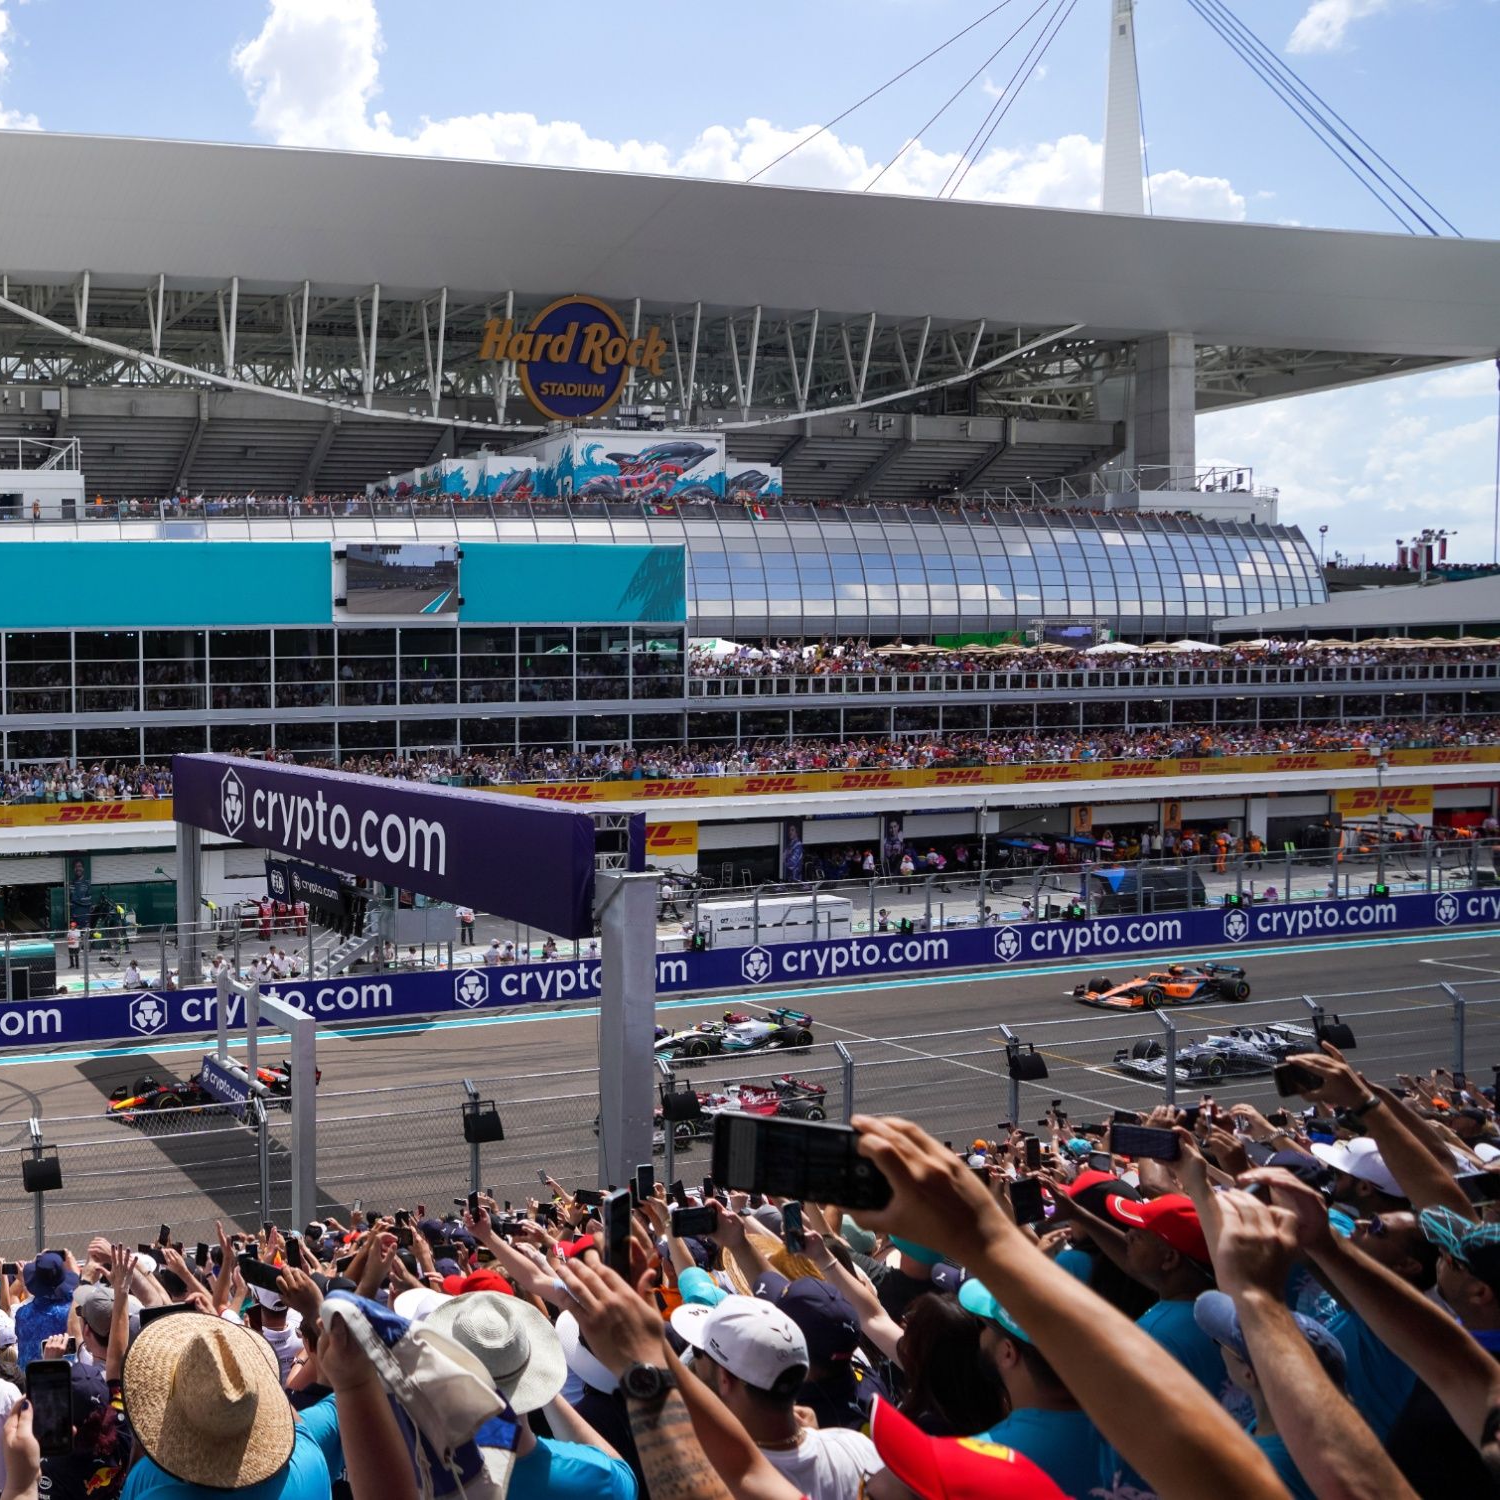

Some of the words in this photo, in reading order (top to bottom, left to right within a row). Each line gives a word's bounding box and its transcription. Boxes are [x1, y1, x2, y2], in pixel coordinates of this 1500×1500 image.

[480, 318, 578, 364] Hard
[579, 322, 668, 376] Rock
[540, 381, 606, 398] STADIUM
[1275, 756, 1319, 769] DHL
[1431, 750, 1474, 763] DHL
[935, 770, 985, 784] DHL
[1024, 766, 1073, 780] DHL
[1111, 763, 1157, 776] DHL
[642, 781, 701, 796] DHL
[744, 777, 799, 792] DHL
[841, 774, 893, 788] DHL
[534, 785, 593, 800] DHL
[1352, 789, 1418, 809] DHL
[57, 804, 129, 821] DHL
[252, 788, 446, 876] crypto.com
[301, 878, 340, 900] crypto.com
[1257, 903, 1397, 936] crypto.com
[1030, 920, 1182, 954] crypto.com
[781, 938, 949, 977] crypto.com
[208, 1073, 246, 1105] crypto.com
